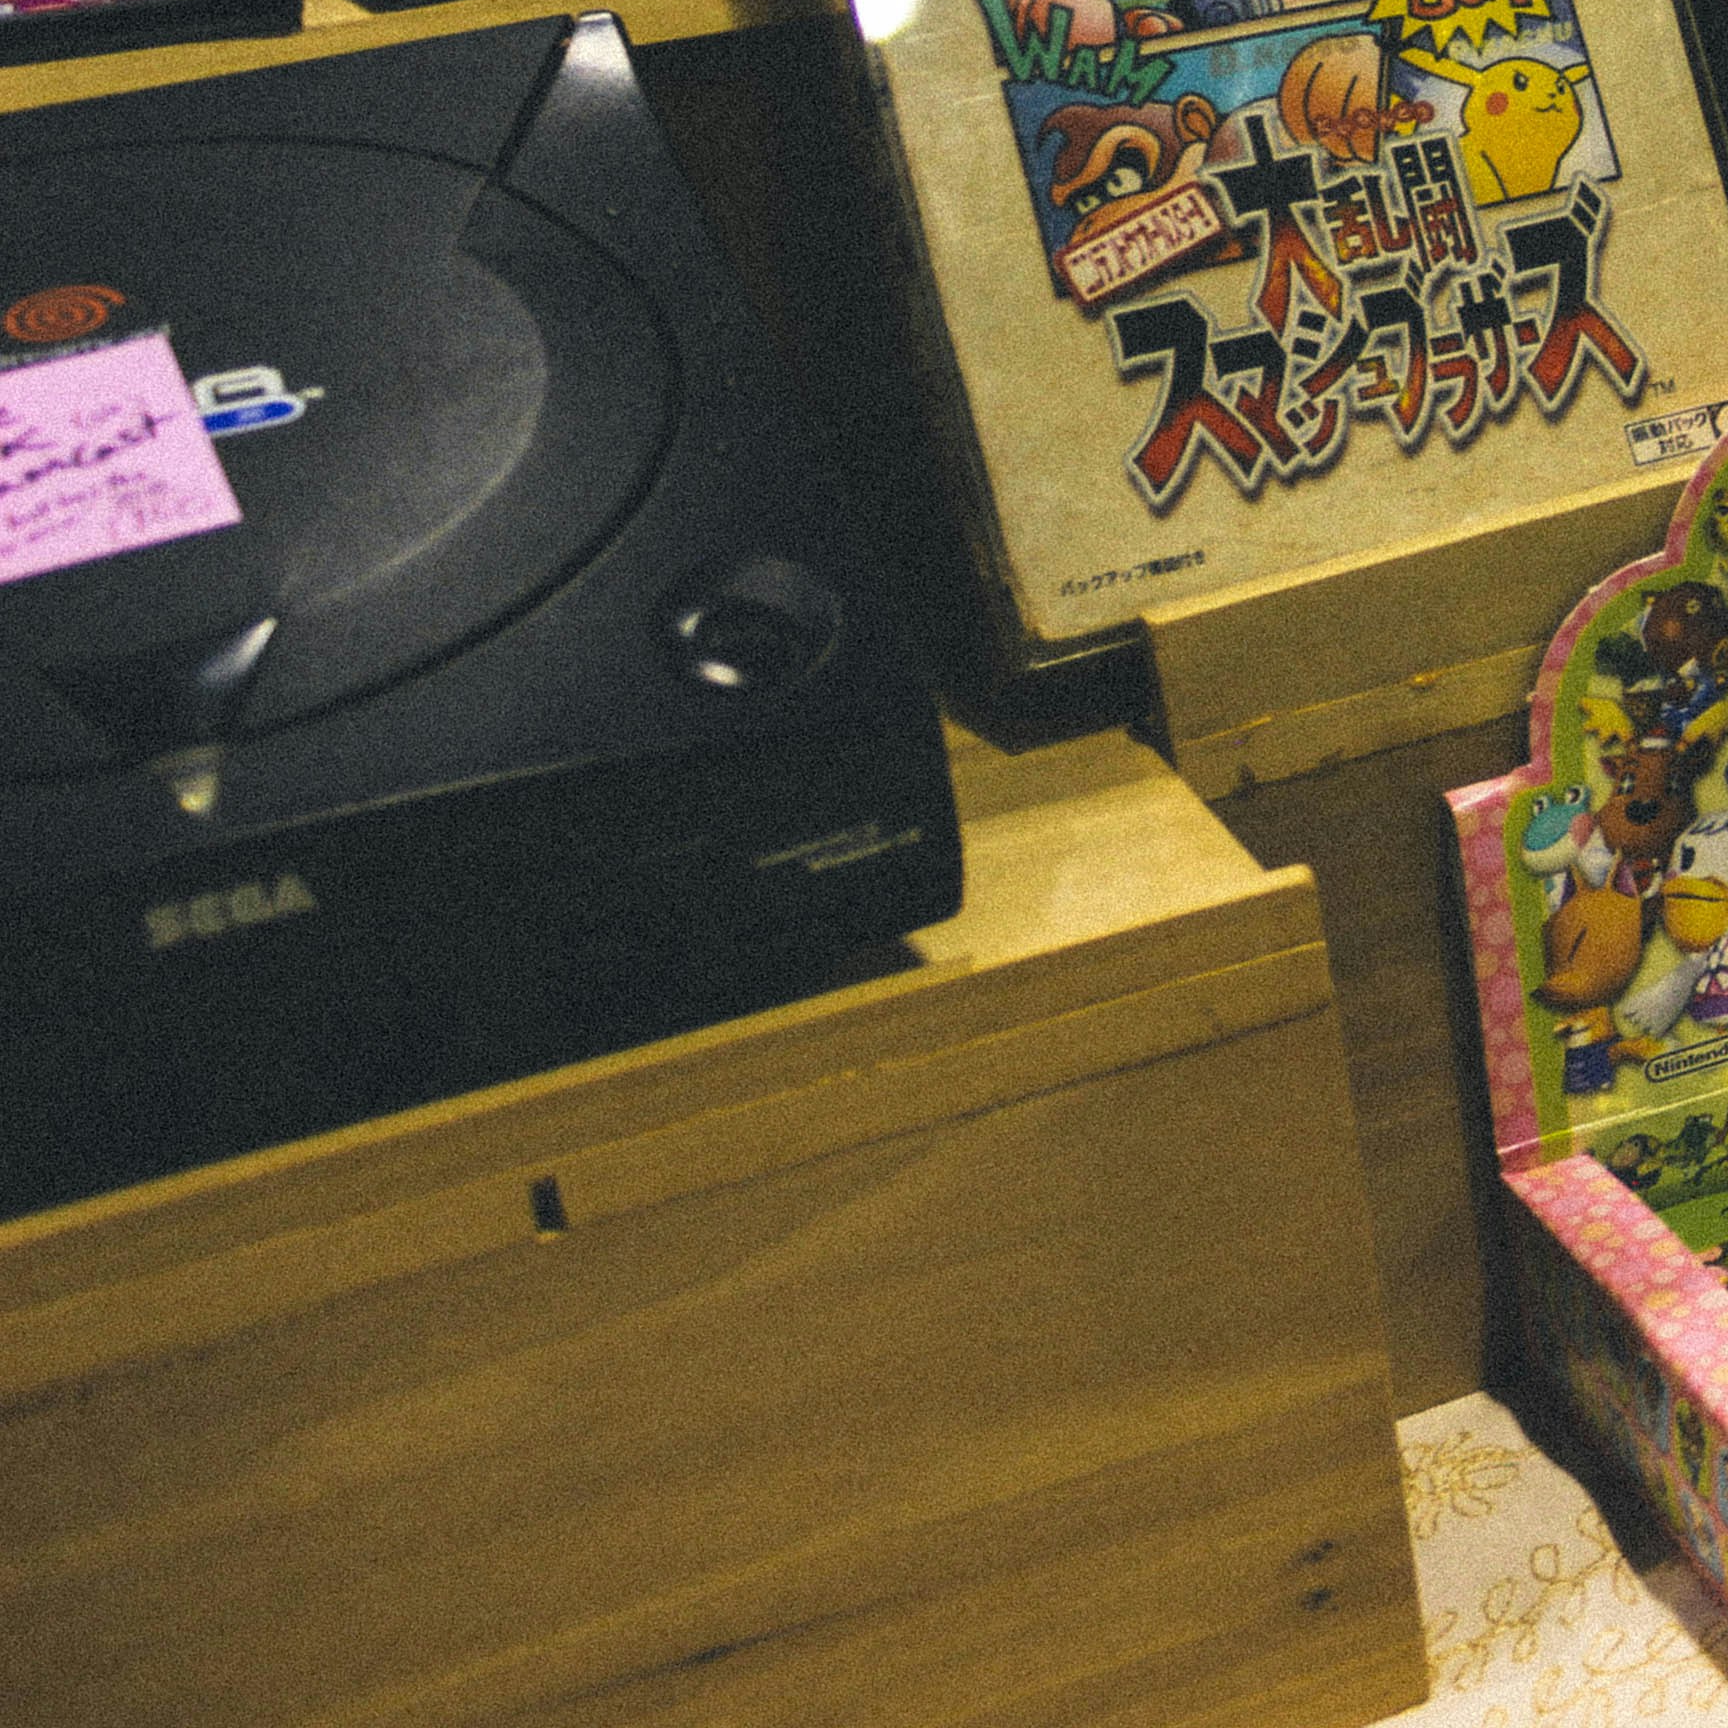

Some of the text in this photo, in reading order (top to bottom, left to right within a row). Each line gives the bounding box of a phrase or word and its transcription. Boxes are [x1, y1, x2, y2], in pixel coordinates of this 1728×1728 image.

[1209, 116, 1480, 332] 大乱闘
[1113, 179, 1641, 486] スマッシュブラザーズ
[143, 873, 318, 950] SEGA
